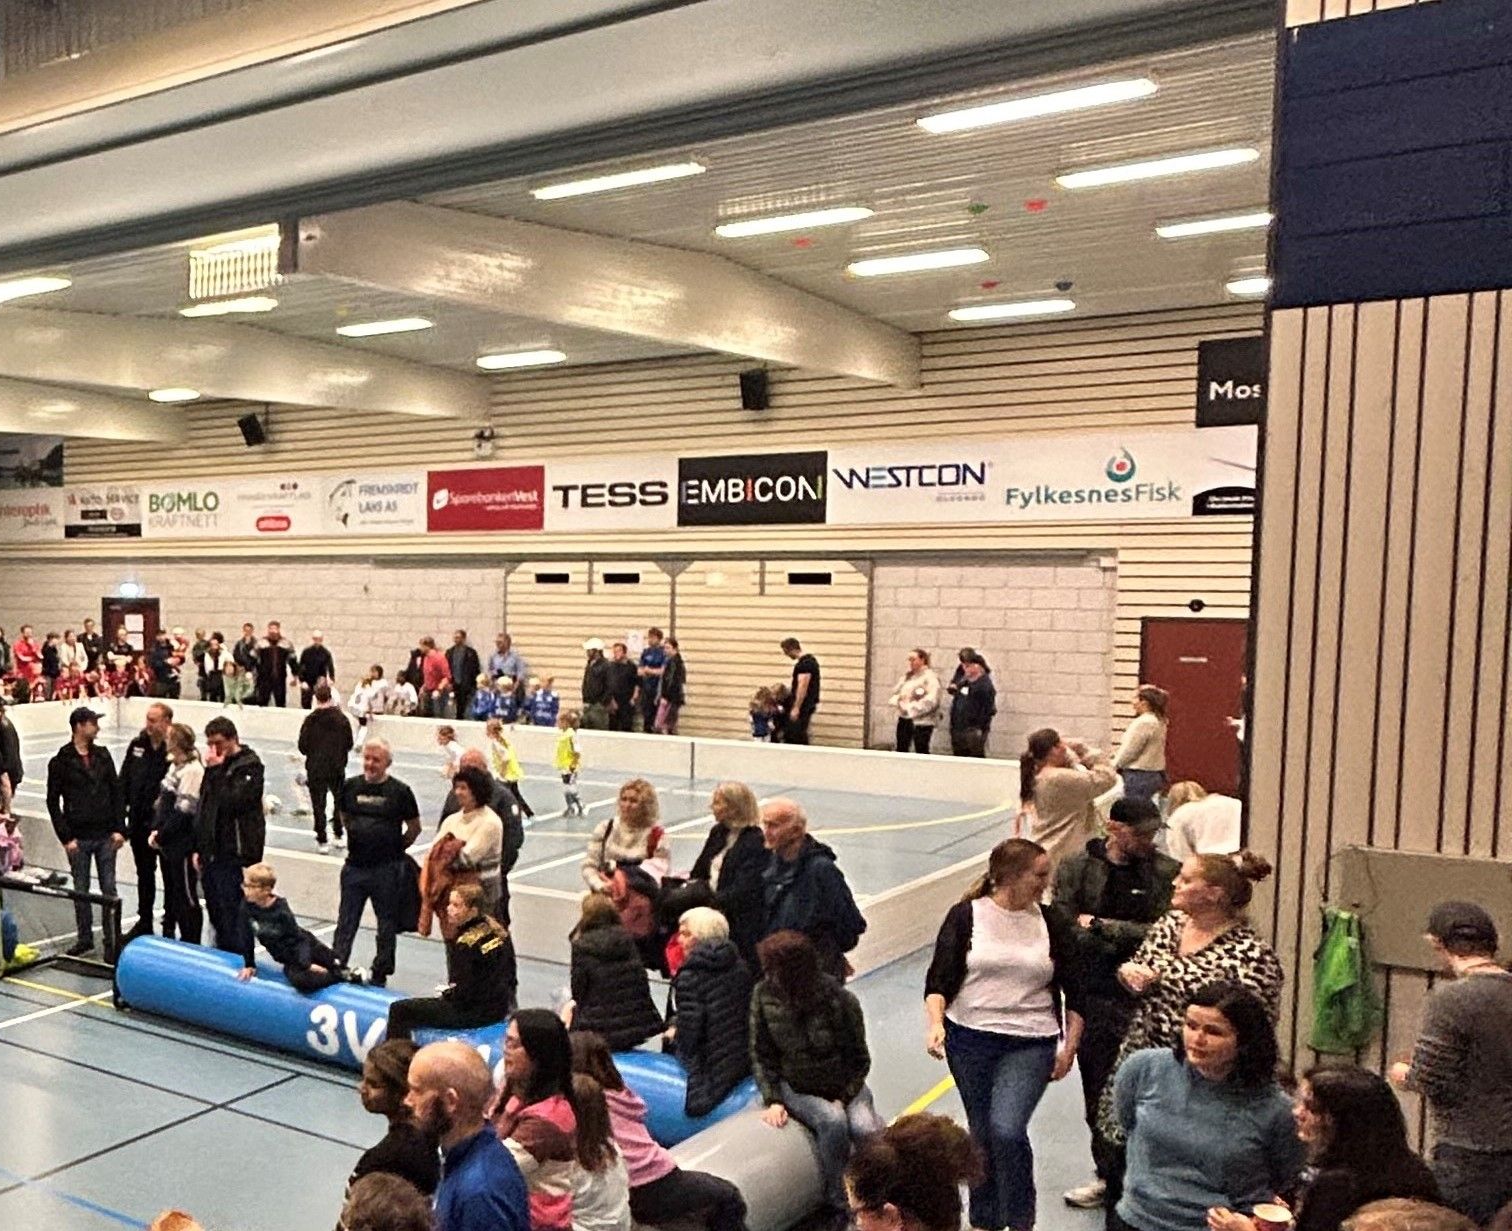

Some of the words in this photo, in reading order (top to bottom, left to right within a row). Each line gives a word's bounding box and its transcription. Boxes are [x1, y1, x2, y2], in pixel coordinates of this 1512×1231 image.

[832, 462, 985, 489] WESTCON
[552, 481, 669, 509] TESS
[1006, 481, 1181, 508] FylkesnesFisk
